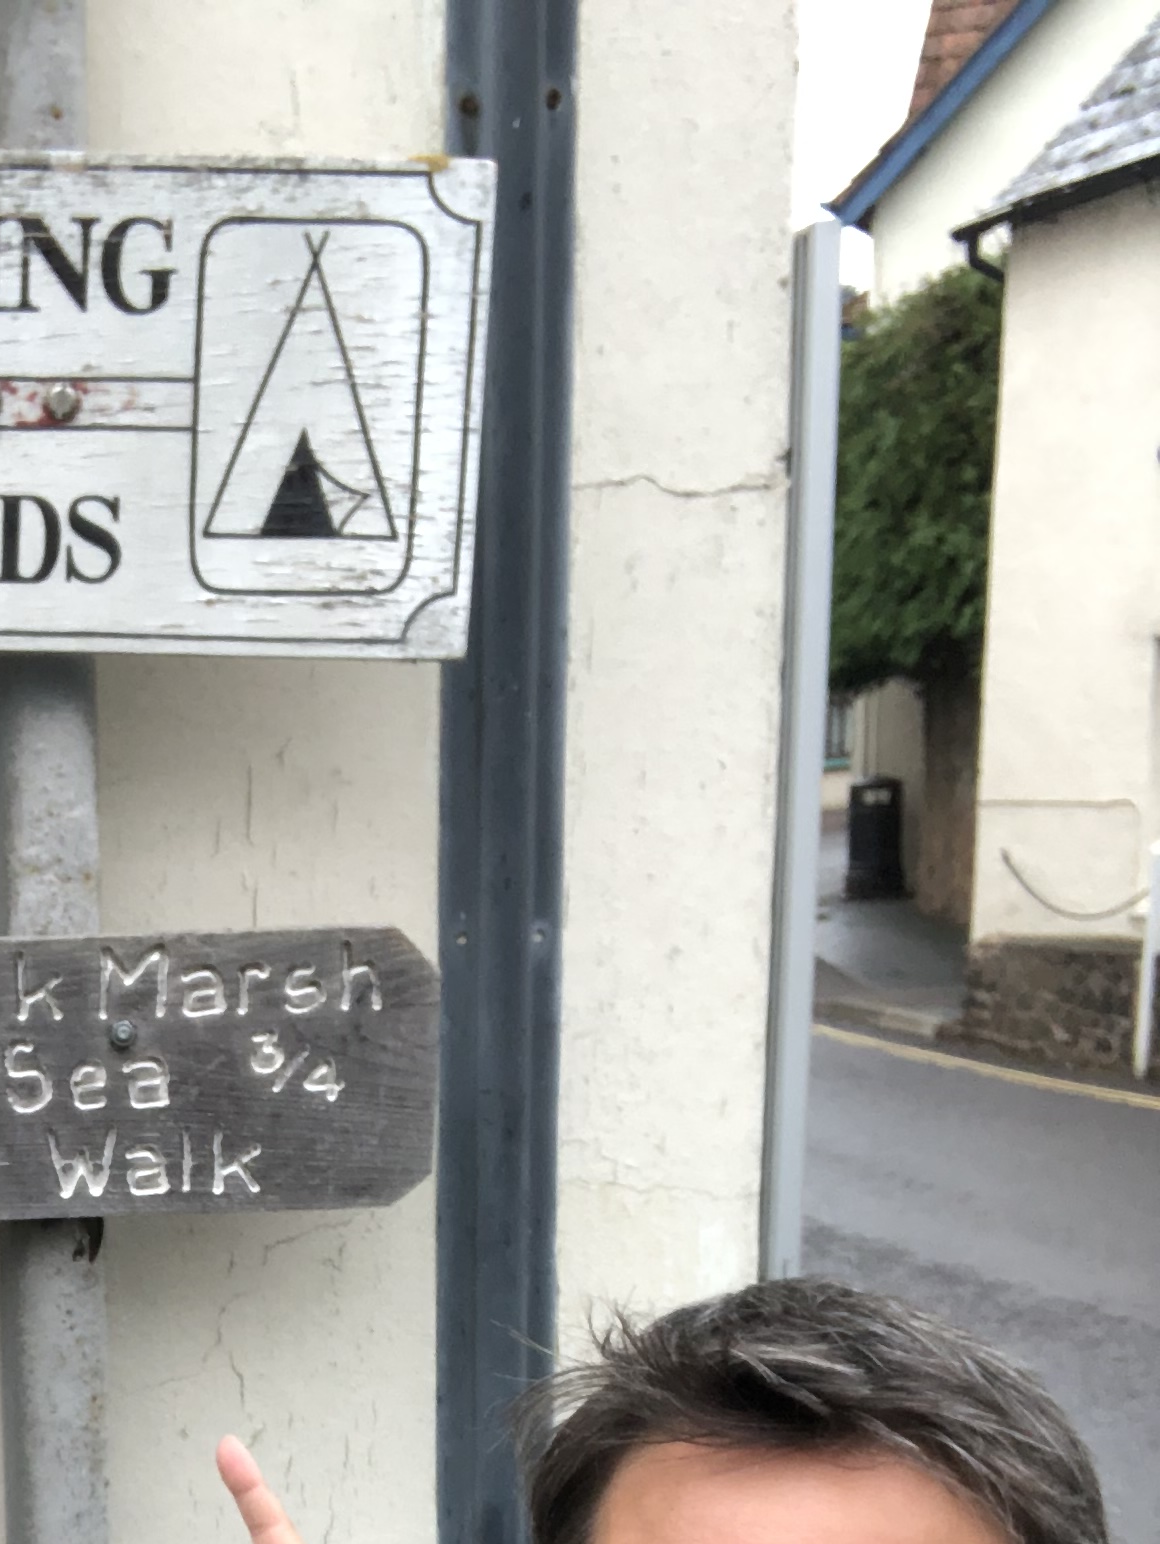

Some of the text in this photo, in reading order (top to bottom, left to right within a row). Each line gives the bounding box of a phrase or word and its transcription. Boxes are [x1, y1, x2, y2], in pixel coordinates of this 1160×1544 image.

[98, 939, 383, 1021] Marsh
[3, 1043, 172, 1115] Sea
[48, 1127, 264, 1199] Walk
